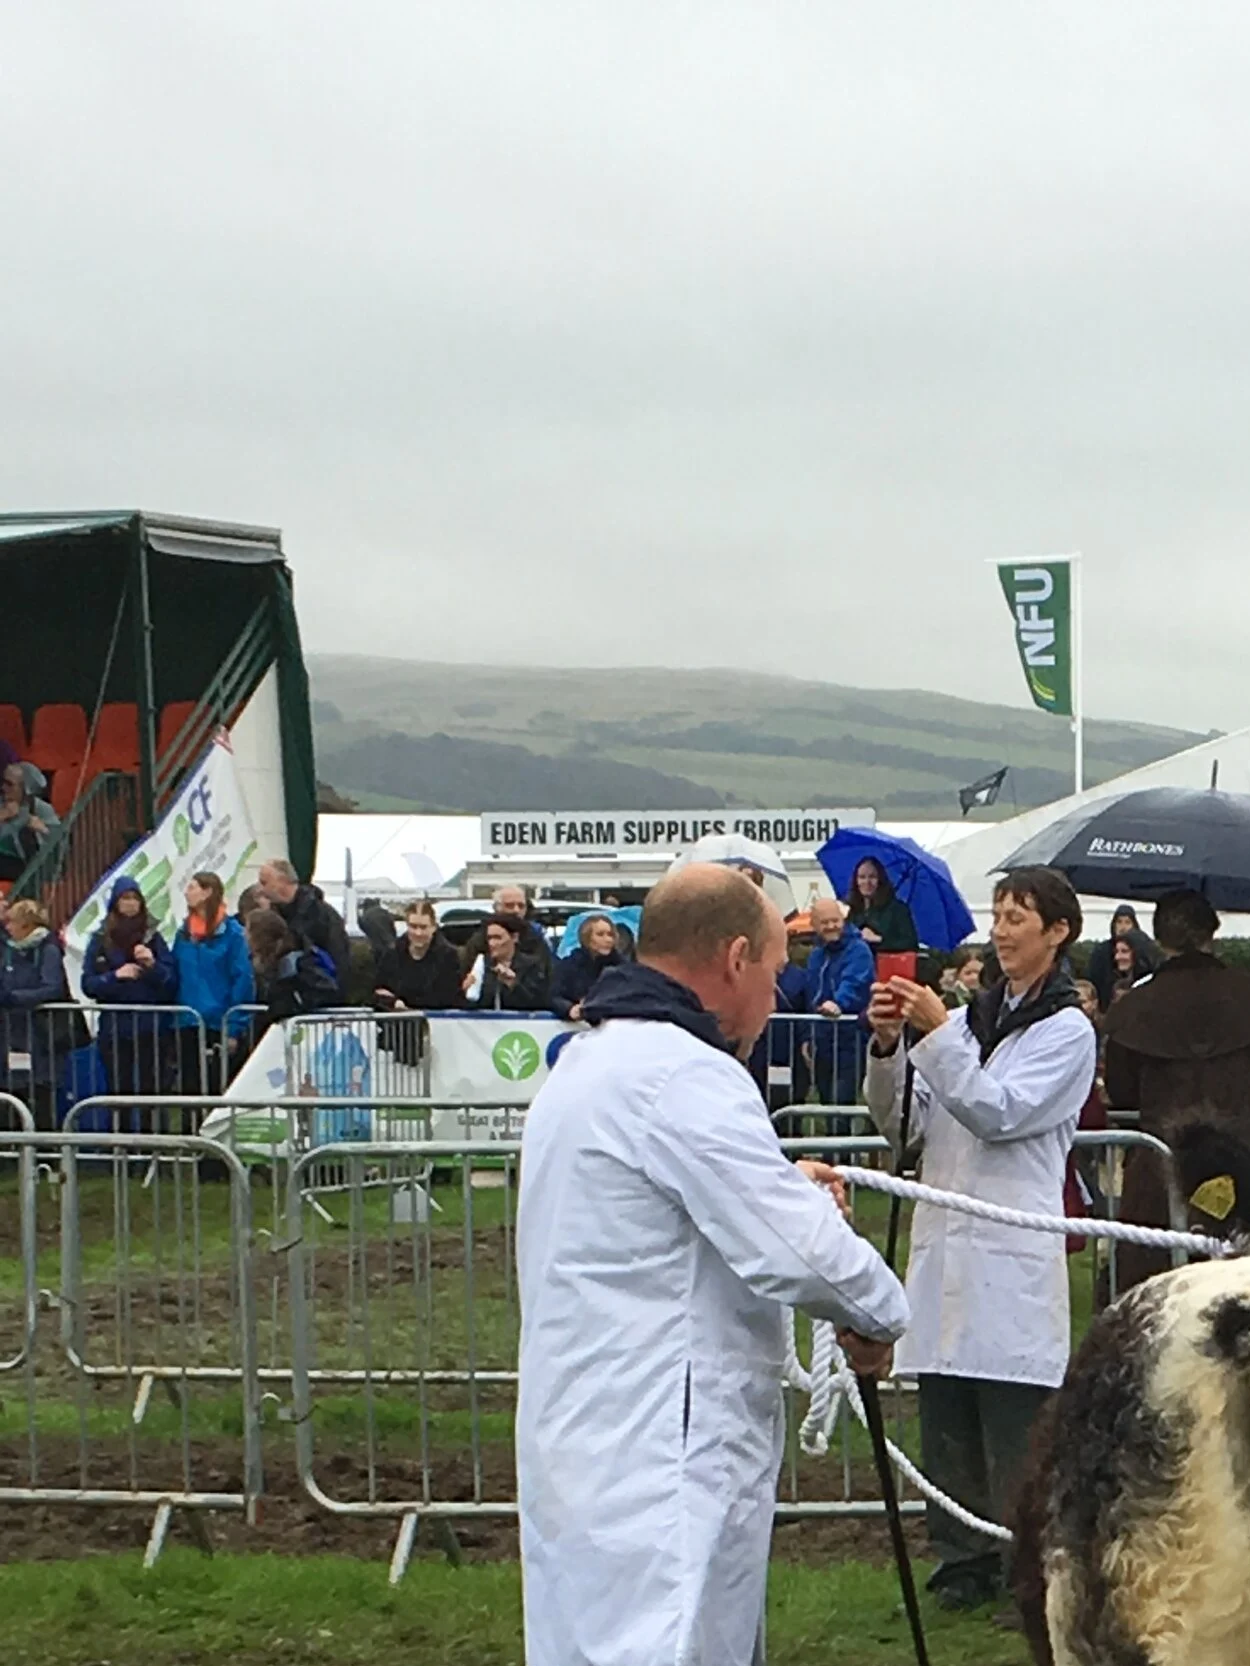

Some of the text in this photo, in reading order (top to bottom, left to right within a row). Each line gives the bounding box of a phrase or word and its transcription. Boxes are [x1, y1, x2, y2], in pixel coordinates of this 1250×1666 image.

[1014, 568, 1056, 666] NFU
[491, 822, 547, 844] EDEN
[555, 821, 616, 844] FARM
[624, 820, 726, 844] SUPPLIES
